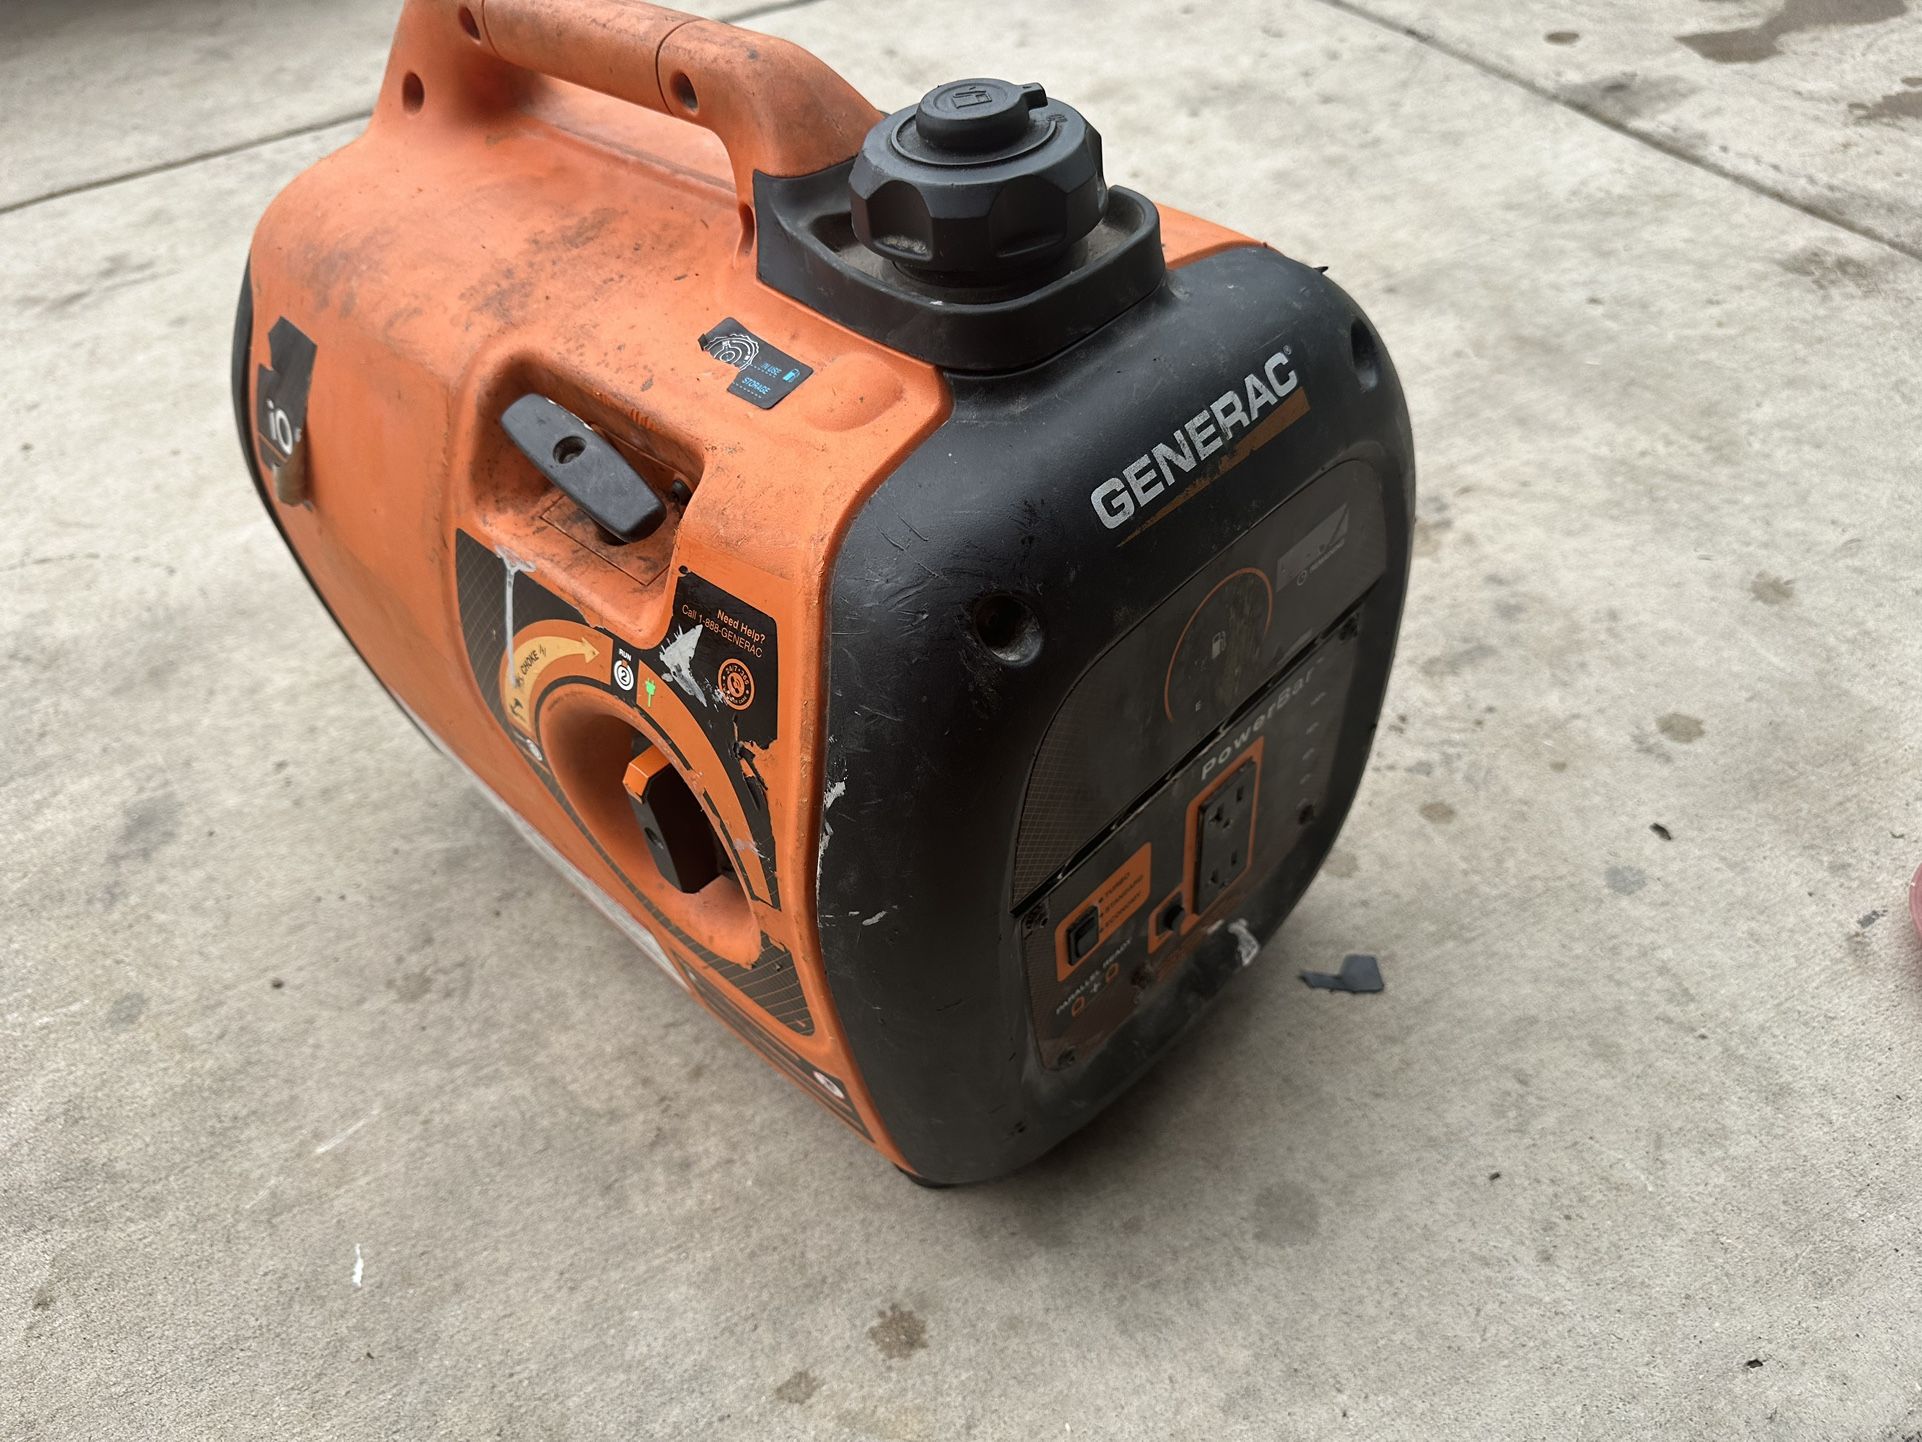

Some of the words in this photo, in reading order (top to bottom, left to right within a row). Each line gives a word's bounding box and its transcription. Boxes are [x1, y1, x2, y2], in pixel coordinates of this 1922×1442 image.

[742, 376, 771, 395] STORAGE
[1091, 352, 1297, 529] GENERAC
[682, 604, 697, 620] Call
[699, 614, 763, 658] 1-888-GENERAC
[717, 609, 739, 629] Need
[740, 622, 766, 644] Help?
[520, 650, 540, 676] CHOKE
[618, 648, 632, 662] RUN
[621, 669, 628, 683] 2
[1201, 667, 1315, 781] PowerBar
